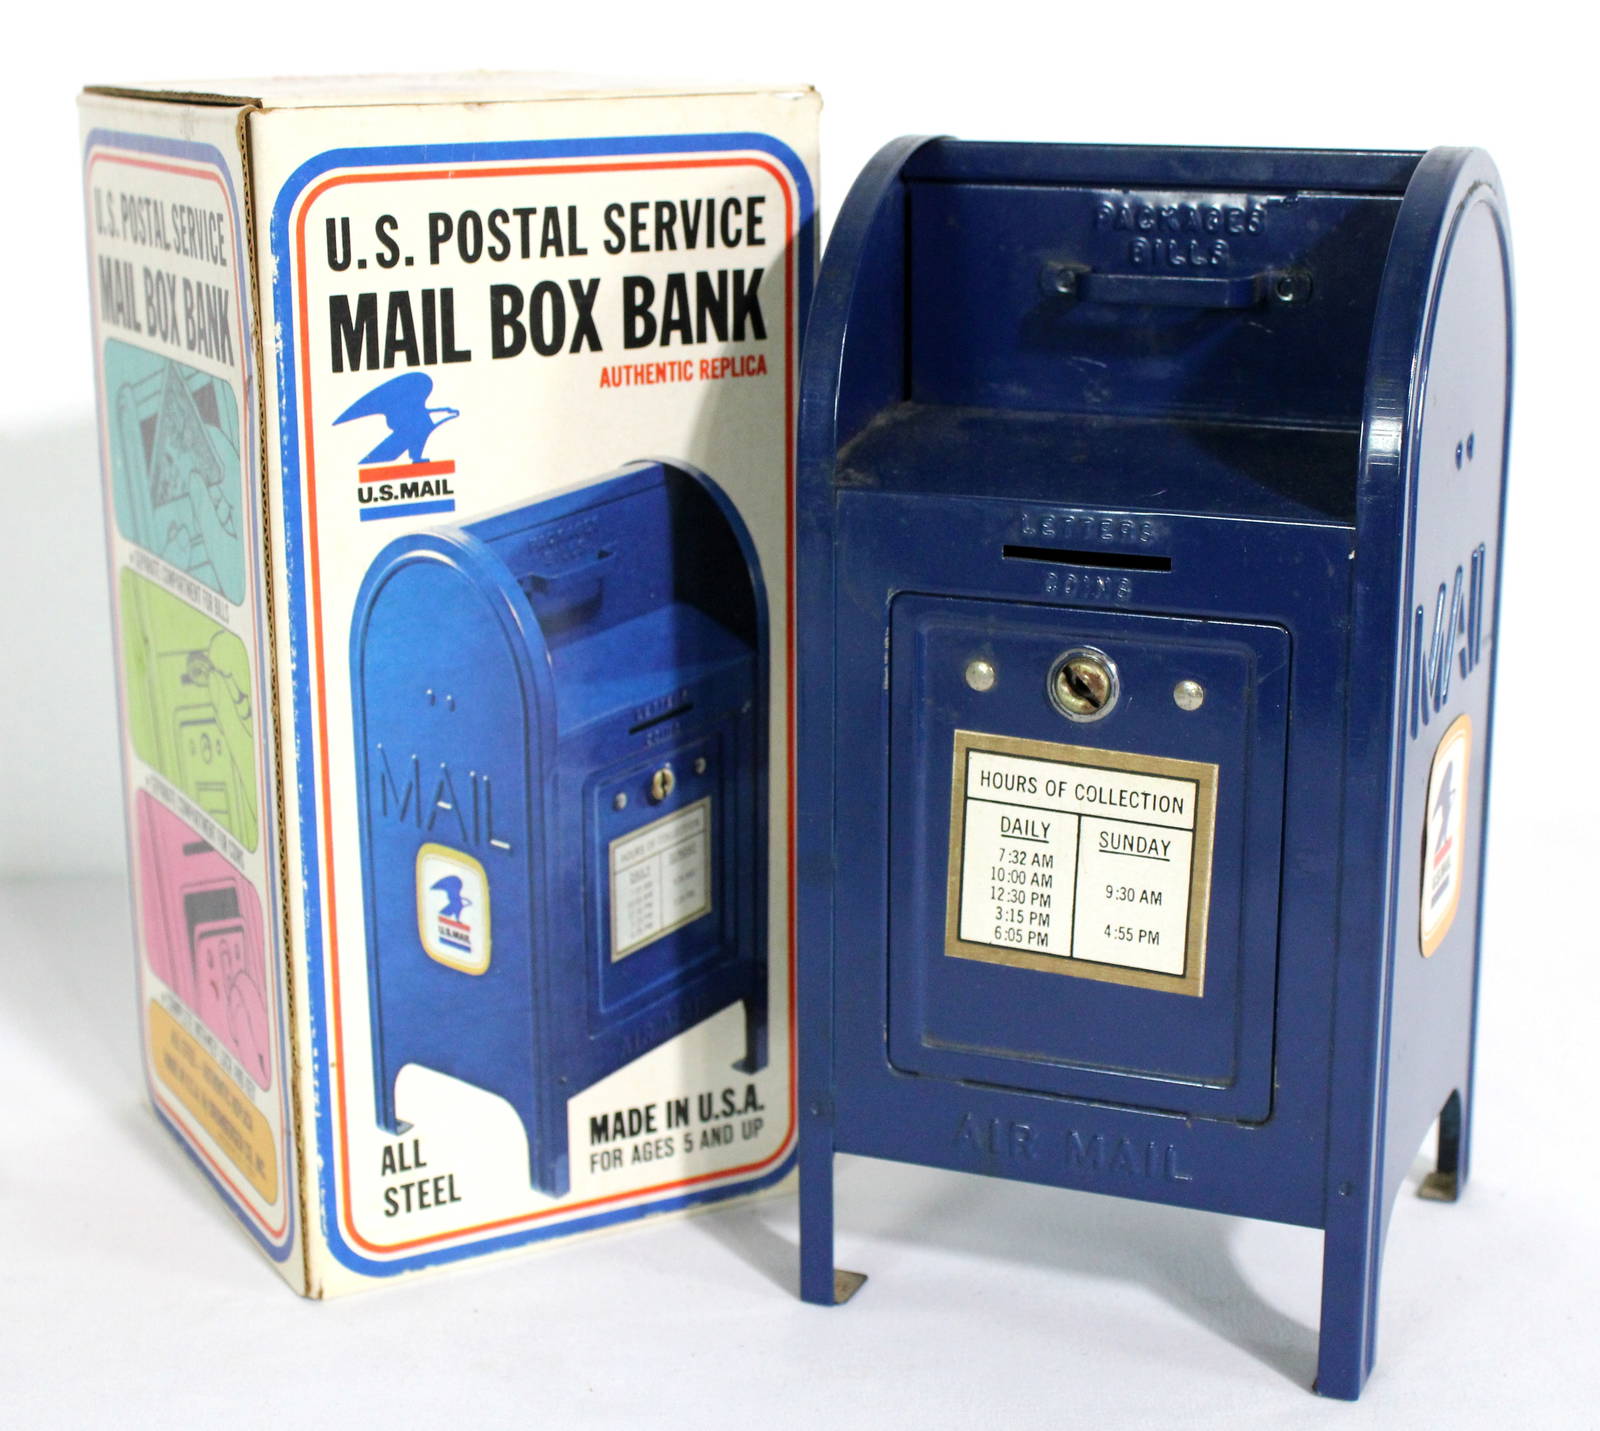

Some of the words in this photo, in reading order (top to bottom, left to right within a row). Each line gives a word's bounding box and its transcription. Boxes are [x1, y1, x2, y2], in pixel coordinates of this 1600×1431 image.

[120, 192, 171, 251] POSTAL
[171, 203, 227, 267] SERVICE
[326, 214, 414, 272] U.S.
[429, 206, 588, 265] POSTAL
[604, 196, 766, 255] SERVICE
[99, 254, 142, 333] MAIL
[143, 266, 181, 347] BOX
[182, 277, 235, 367] BANK
[329, 288, 472, 373] MAIL
[490, 277, 603, 359] BOX
[622, 268, 767, 349] BANK
[600, 360, 694, 388] AUTHENTIC
[701, 354, 768, 380] REPLICA
[1021, 513, 1154, 543] LETTERS
[377, 743, 512, 852] MAIL
[980, 770, 1038, 794] HOURS
[1045, 780, 1068, 798] OF
[1075, 783, 1185, 815] COLLECTION
[1001, 816, 1051, 839] DAILY
[1099, 830, 1172, 858] SUNDAY
[999, 848, 1027, 865] 7:32
[1031, 853, 1054, 869] AM
[991, 866, 1027, 885] 10:00
[1030, 873, 1053, 888] AM
[991, 886, 1026, 904] 12:30
[1031, 892, 1052, 908] PM
[1105, 885, 1136, 902] 9:30
[1139, 891, 1163, 906] AM
[995, 906, 1025, 924] 3:15
[1029, 912, 1050, 927] PM
[994, 926, 1024, 943] 6:05
[1028, 931, 1049, 947] PM
[1104, 925, 1134, 942] 4:55
[1138, 930, 1160, 946] PM
[589, 1106, 656, 1146] MADE
[666, 1098, 689, 1129] IN
[699, 1084, 765, 1123] U.S.A.
[381, 1138, 427, 1176] ALL
[590, 1151, 625, 1174] FOR
[631, 1140, 675, 1166] AGES
[684, 1133, 694, 1153] 5
[700, 1124, 733, 1149] AND
[742, 1118, 764, 1141] UP
[953, 1112, 1036, 1159] AIR
[1064, 1128, 1193, 1182] MAIL
[384, 1174, 461, 1218] STEEL
